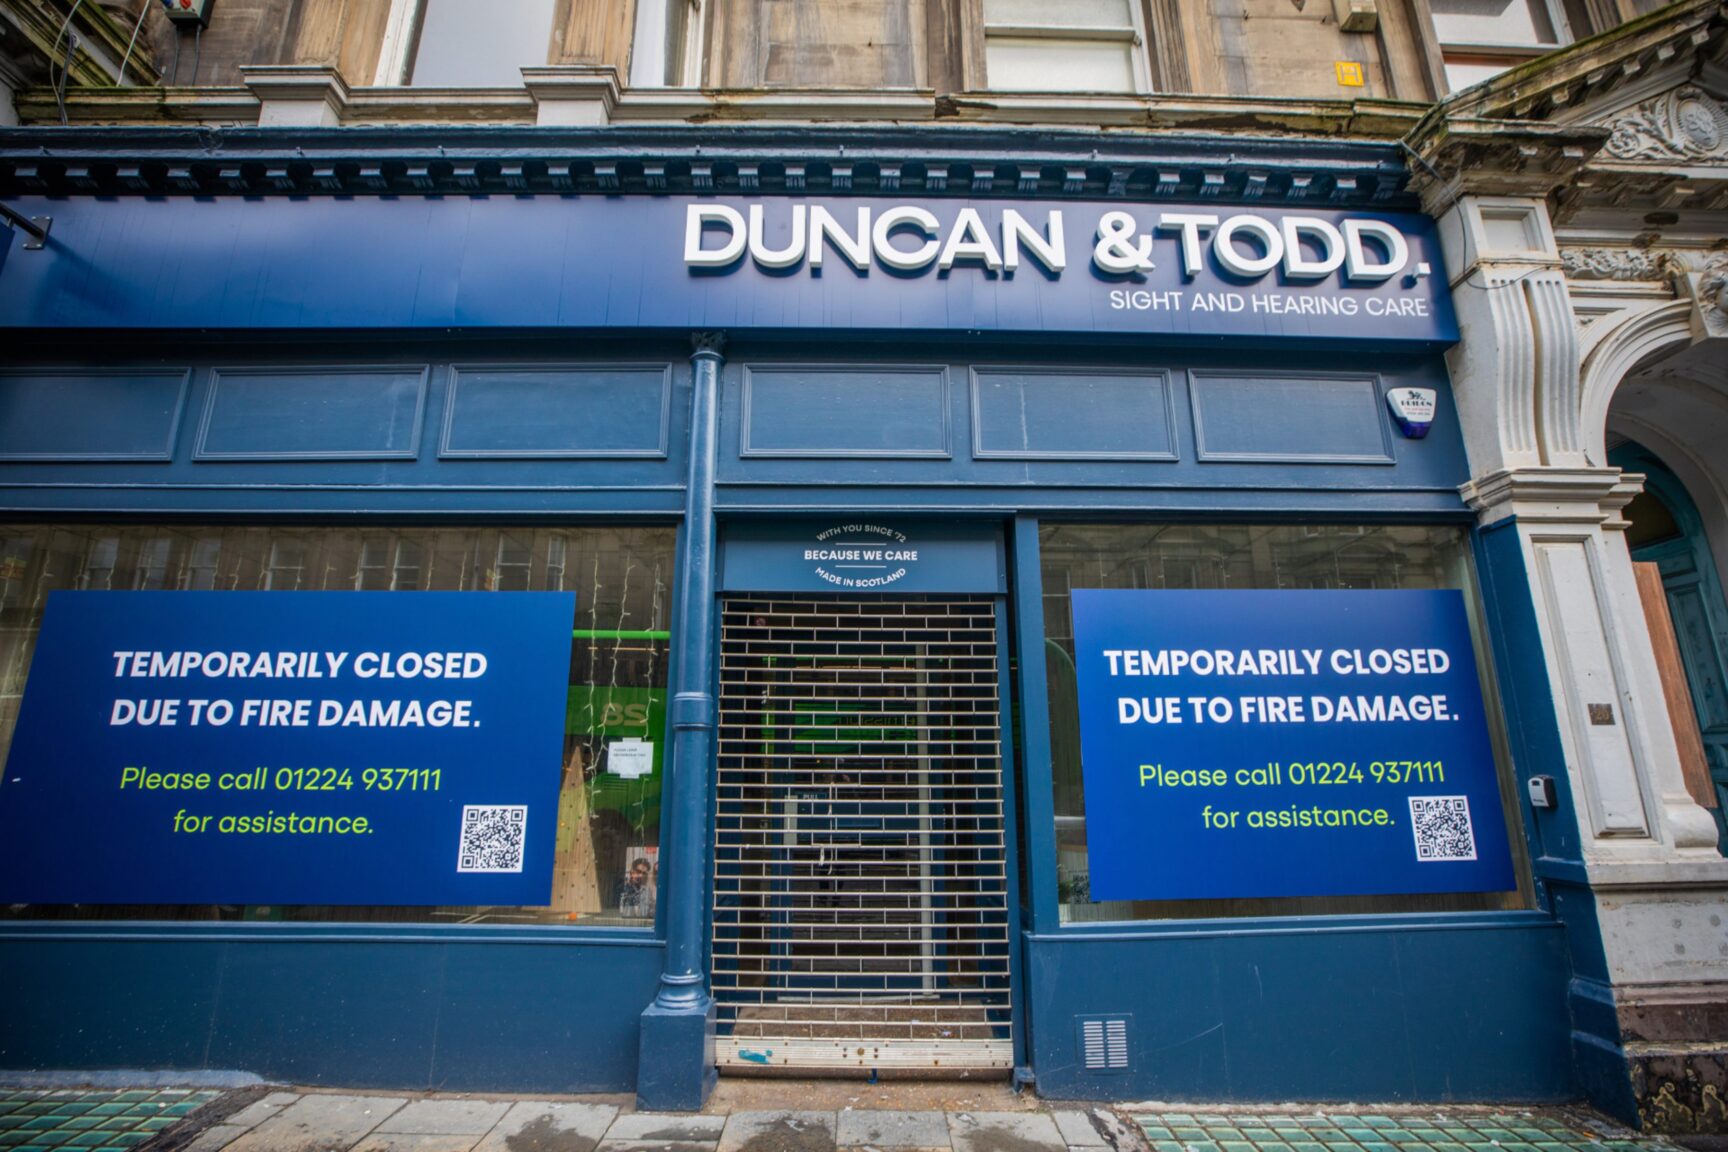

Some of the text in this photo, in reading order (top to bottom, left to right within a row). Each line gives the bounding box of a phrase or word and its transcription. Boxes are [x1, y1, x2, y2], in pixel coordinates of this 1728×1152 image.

[683, 203, 1432, 281] DUNCAN & TODD.
[1109, 289, 1430, 318] SIGHT AND HEARING CARE
[816, 527, 841, 541] WITH
[842, 524, 863, 533] YOU
[864, 524, 893, 537] SINCE
[804, 550, 918, 561] BECAUSE WE CARE
[815, 567, 907, 588] MADE IN SCOTLAND
[113, 651, 488, 679] TEMPORARILY CLOSED
[1103, 648, 1451, 676] TEMPORARILY CLOSED
[110, 699, 481, 728] DUE TO FIRE DAMAGE.
[1118, 695, 1460, 724] DUE TO FIRE DAMAGE.
[120, 767, 441, 791] Please call 01224 937111
[1139, 760, 1445, 788] Please call 01224 937111
[173, 809, 374, 834] for assistance.
[1202, 804, 1396, 830] for assistance.
